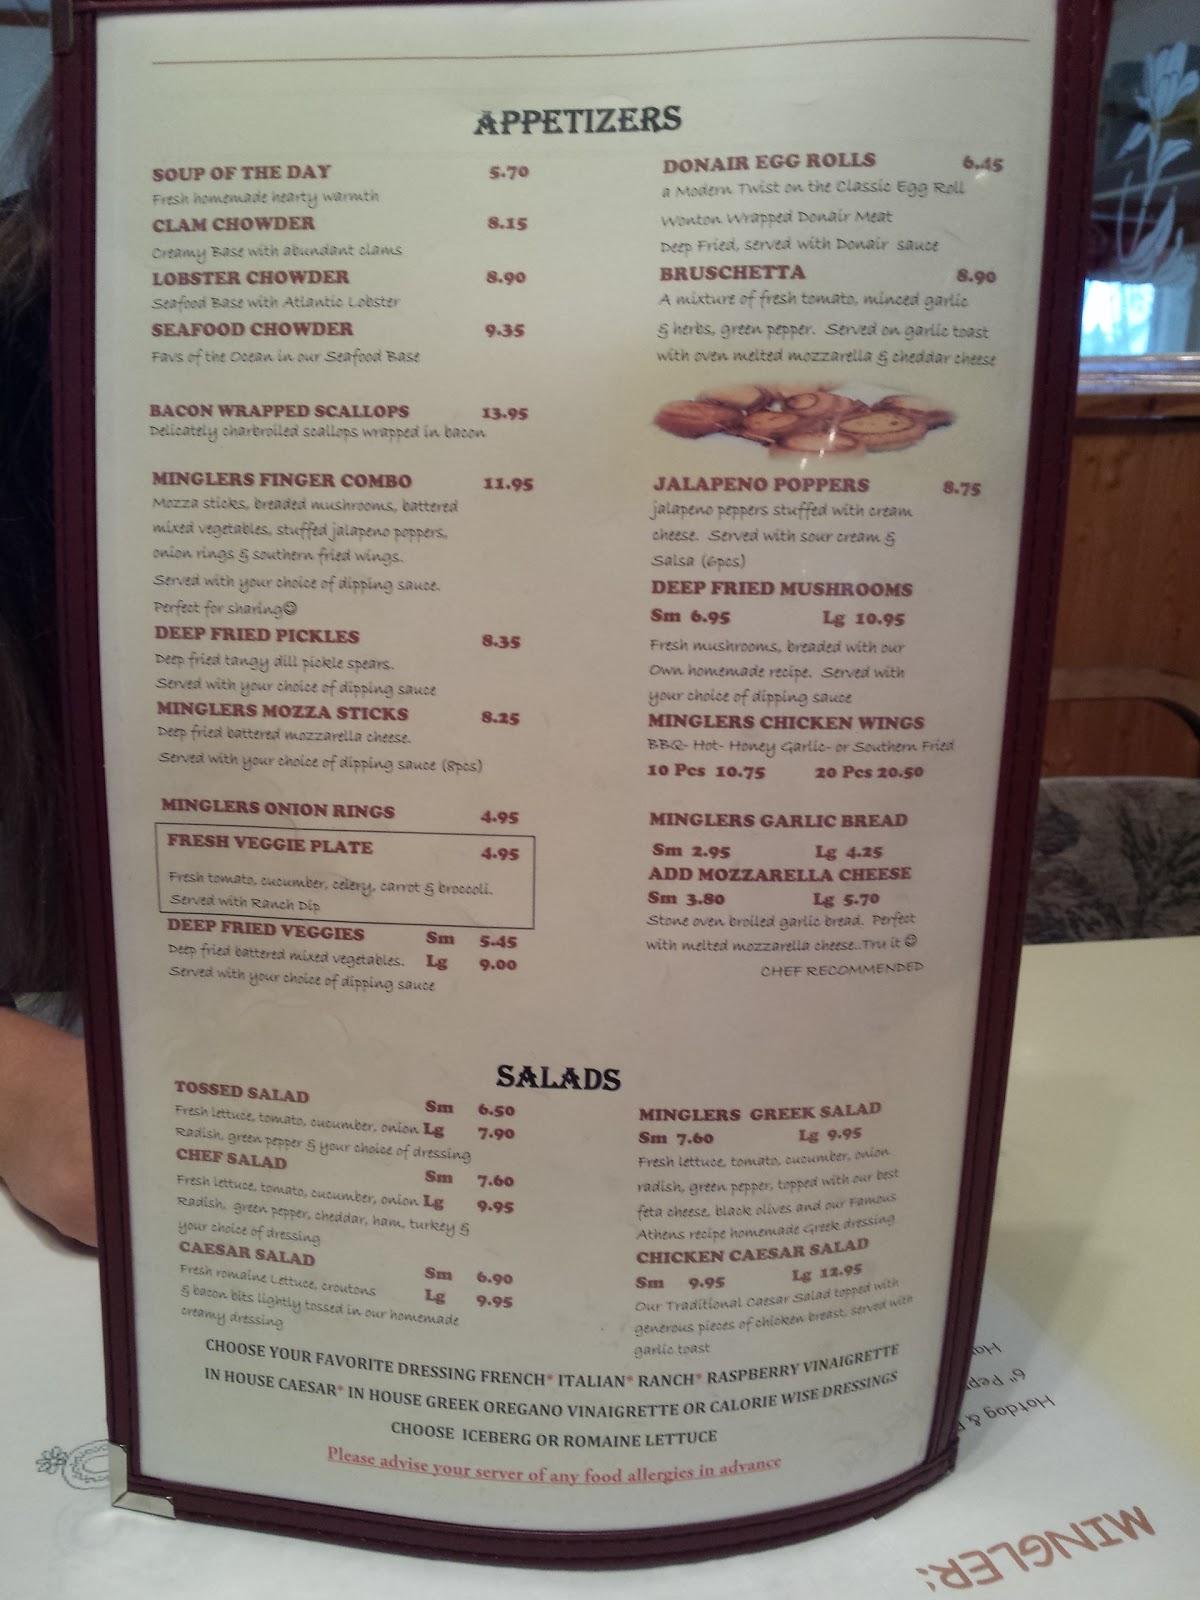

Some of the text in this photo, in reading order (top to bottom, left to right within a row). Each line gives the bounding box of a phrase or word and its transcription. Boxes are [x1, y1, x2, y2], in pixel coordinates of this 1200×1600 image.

[474, 105, 682, 135] APPETIZERS
[663, 152, 876, 174] DONAIR EGG ROLLS
[152, 165, 331, 182] SOUP OF THE DAY
[490, 166, 529, 180] 5.70
[152, 191, 379, 209] Fresh homemade hearty warmth
[153, 216, 315, 233] CLAM CHOWDER
[488, 217, 527, 231] 8.15
[661, 209, 893, 226] Wonton Wrapped Donair Meat
[153, 270, 349, 286] LOBSTER CHOWDER
[487, 271, 526, 285] 8.90
[660, 265, 806, 281] BRUSCHETTA
[957, 269, 996, 285] 8.90
[152, 322, 353, 337] SEAFOOD CHOWDER
[485, 324, 524, 337] 9.35
[150, 404, 409, 418] BACON WRAPPED SCALLOPS
[482, 408, 528, 420] 13.95
[150, 425, 485, 443] Delicately charbroiled scallops wrapped in bacon
[152, 472, 412, 488] MINGLERS FINGER COMBO
[484, 478, 533, 491] 11.95
[654, 476, 869, 492] JALAPENO POPPERS
[943, 481, 981, 496] 8.75
[651, 554, 745, 571] Salsa (6pcs)
[652, 580, 912, 597] DEEP FRIED MUSHROOMS
[154, 600, 200, 613] Perfect
[204, 600, 224, 617] for
[651, 608, 730, 625] Sm 6.95
[823, 610, 905, 628] Lg 10.95
[155, 626, 360, 644] DEEP FRIED PICKLES
[482, 634, 520, 649] 8.35
[157, 701, 408, 721] MINGLERS MOZZA STICKS
[482, 711, 519, 725] 8.25
[649, 714, 924, 730] MINGLERS CHICKEN WINGS
[157, 724, 411, 744] Deep fried battered mozzarella cheese.
[162, 798, 395, 819] MINGLERS ONION RINGS
[481, 811, 519, 824] 4.95
[650, 812, 908, 828] MINGLERS GARLIC BREAD
[168, 834, 373, 854] FRESH VEGGIE PLATE
[481, 847, 519, 861] 4.95
[648, 867, 911, 882] ADD MOZZARELLA CHEESE
[169, 895, 320, 912] Served with Ranch Dip
[168, 918, 364, 941] DEEP FRIED VEGGIES
[761, 961, 924, 976] CHEF RECOMMENDED
[496, 1065, 621, 1091] SALADS
[175, 1081, 309, 1103] TOSSED SALAD
[640, 1102, 881, 1121] MINGLERS GREEK SALAD
[176, 1148, 287, 1169] CHEF SALAD
[179, 1241, 315, 1266] CAESAR SALAD
[637, 1238, 869, 1264] CHICKEN CAESAR SALAD
[634, 1342, 710, 1359] garlic toast
[206, 1339, 265, 1357] CHOOSE
[270, 1346, 311, 1363] YOUR
[316, 1352, 393, 1373] FAVORITE
[398, 1362, 475, 1381] DRESSING
[708, 1363, 799, 1384] RASPBERRY
[803, 1344, 899, 1373] VINAIGRETTE
[966, 1374, 1004, 1390] Pep
[205, 1368, 220, 1380] IN
[225, 1370, 274, 1388] HOUSE
[349, 1386, 363, 1399] IN
[370, 1389, 421, 1406] HOUSE
[426, 1396, 479, 1412] GREEK
[484, 1401, 562, 1416] OREGANO
[567, 1404, 678, 1418] VINAIGRETTE
[683, 1402, 705, 1414] OR
[710, 1392, 777, 1413] CALORIE
[781, 1387, 819, 1404] WISE
[822, 1371, 897, 1398] DRESSINGS
[983, 1394, 1056, 1419] Hotdog
[965, 1413, 981, 1427] &
[391, 1422, 717, 1447] CHOOSE ICEBERG OR ROMAINE LETTUCE
[328, 1446, 781, 1486] Please advise your server of any food allergies in advance
